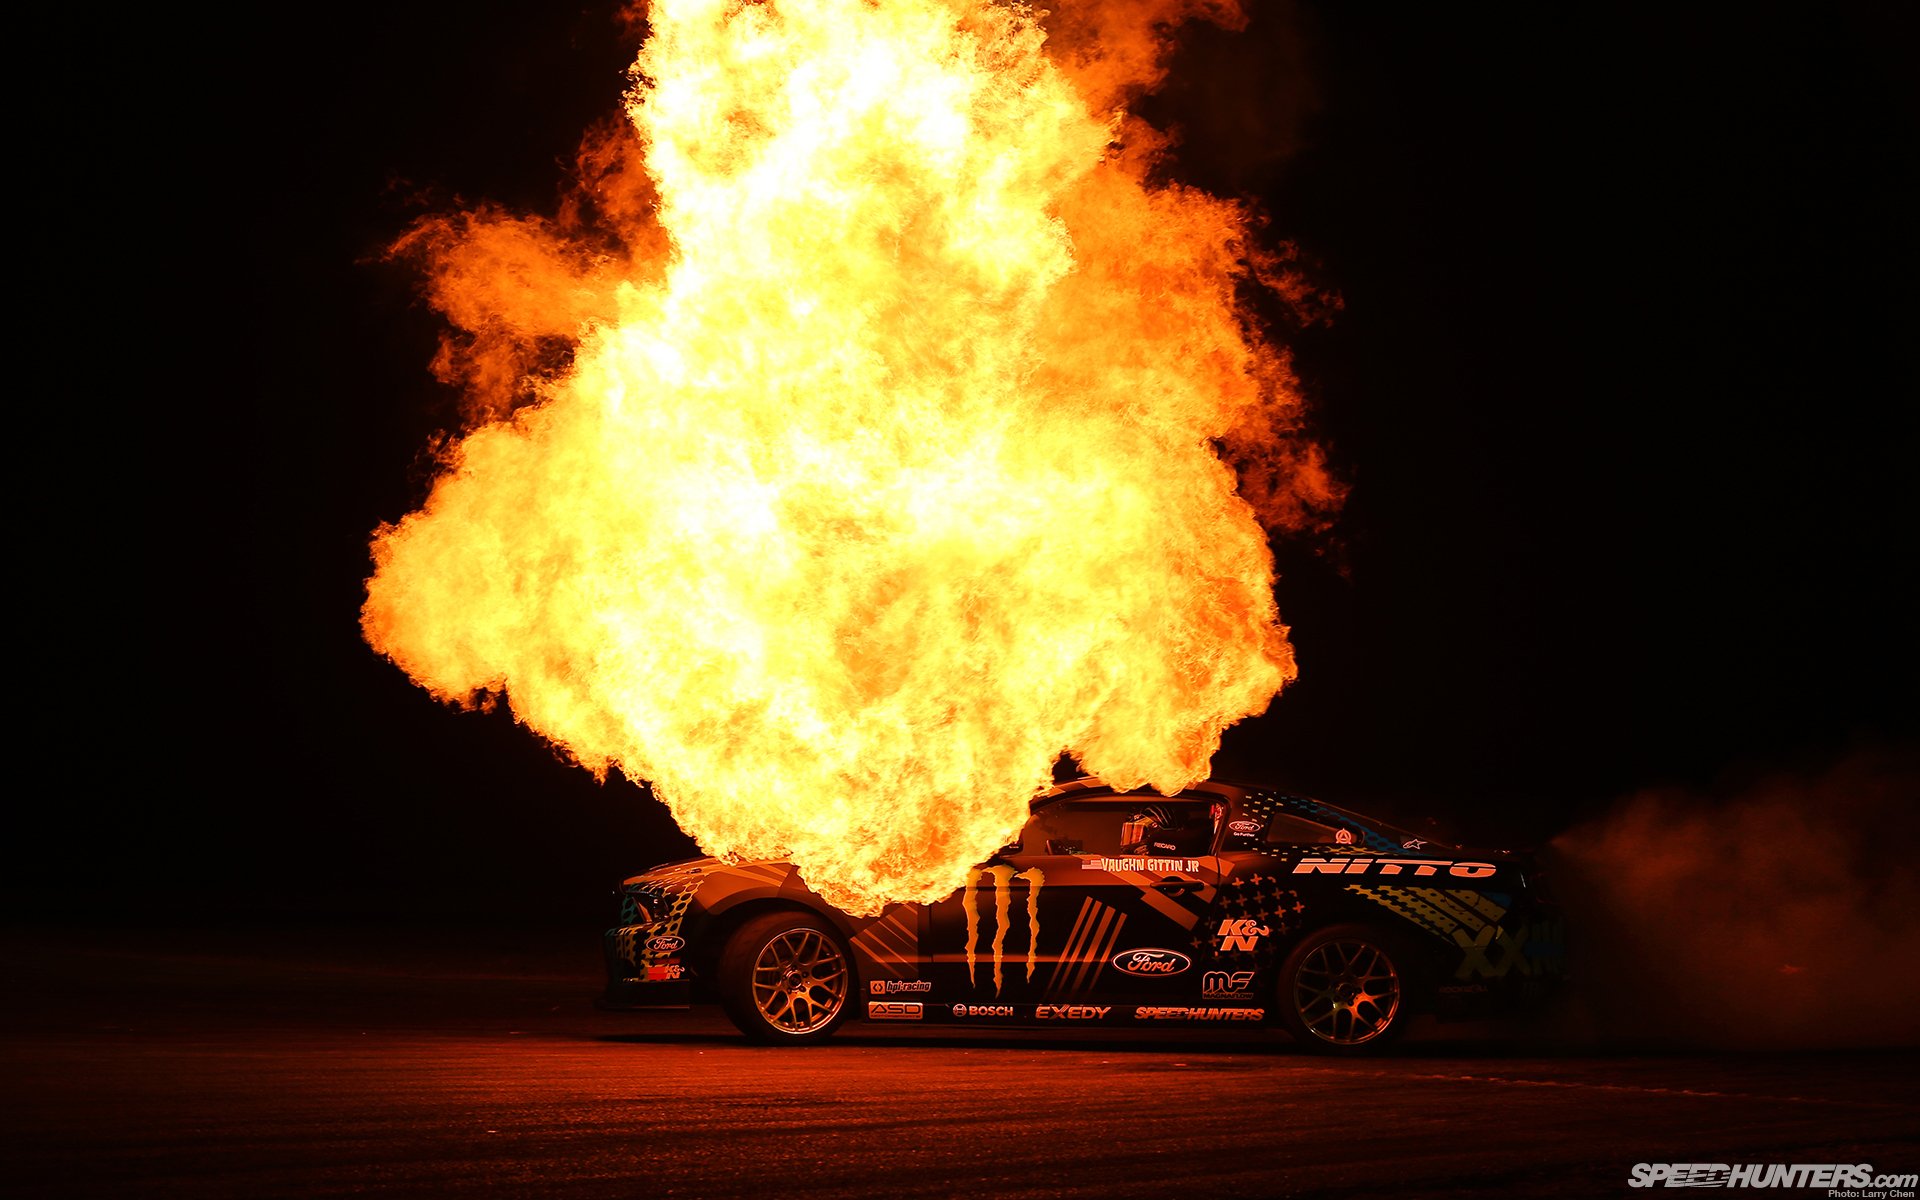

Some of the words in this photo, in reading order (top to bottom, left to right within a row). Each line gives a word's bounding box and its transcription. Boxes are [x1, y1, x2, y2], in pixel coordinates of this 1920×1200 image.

[1101, 858, 1144, 872] VAUGHN
[1147, 859, 1183, 873] GITTIN
[1186, 860, 1200, 873] JR
[1292, 858, 1497, 878] NITTO
[653, 937, 679, 950] Ford
[1127, 951, 1175, 973] Ford
[871, 1003, 921, 1015] ASD
[968, 1005, 1014, 1016] BOSCH
[1035, 1004, 1112, 1020] EXEDY
[1133, 1006, 1265, 1021] SPEEDHUNTERS
